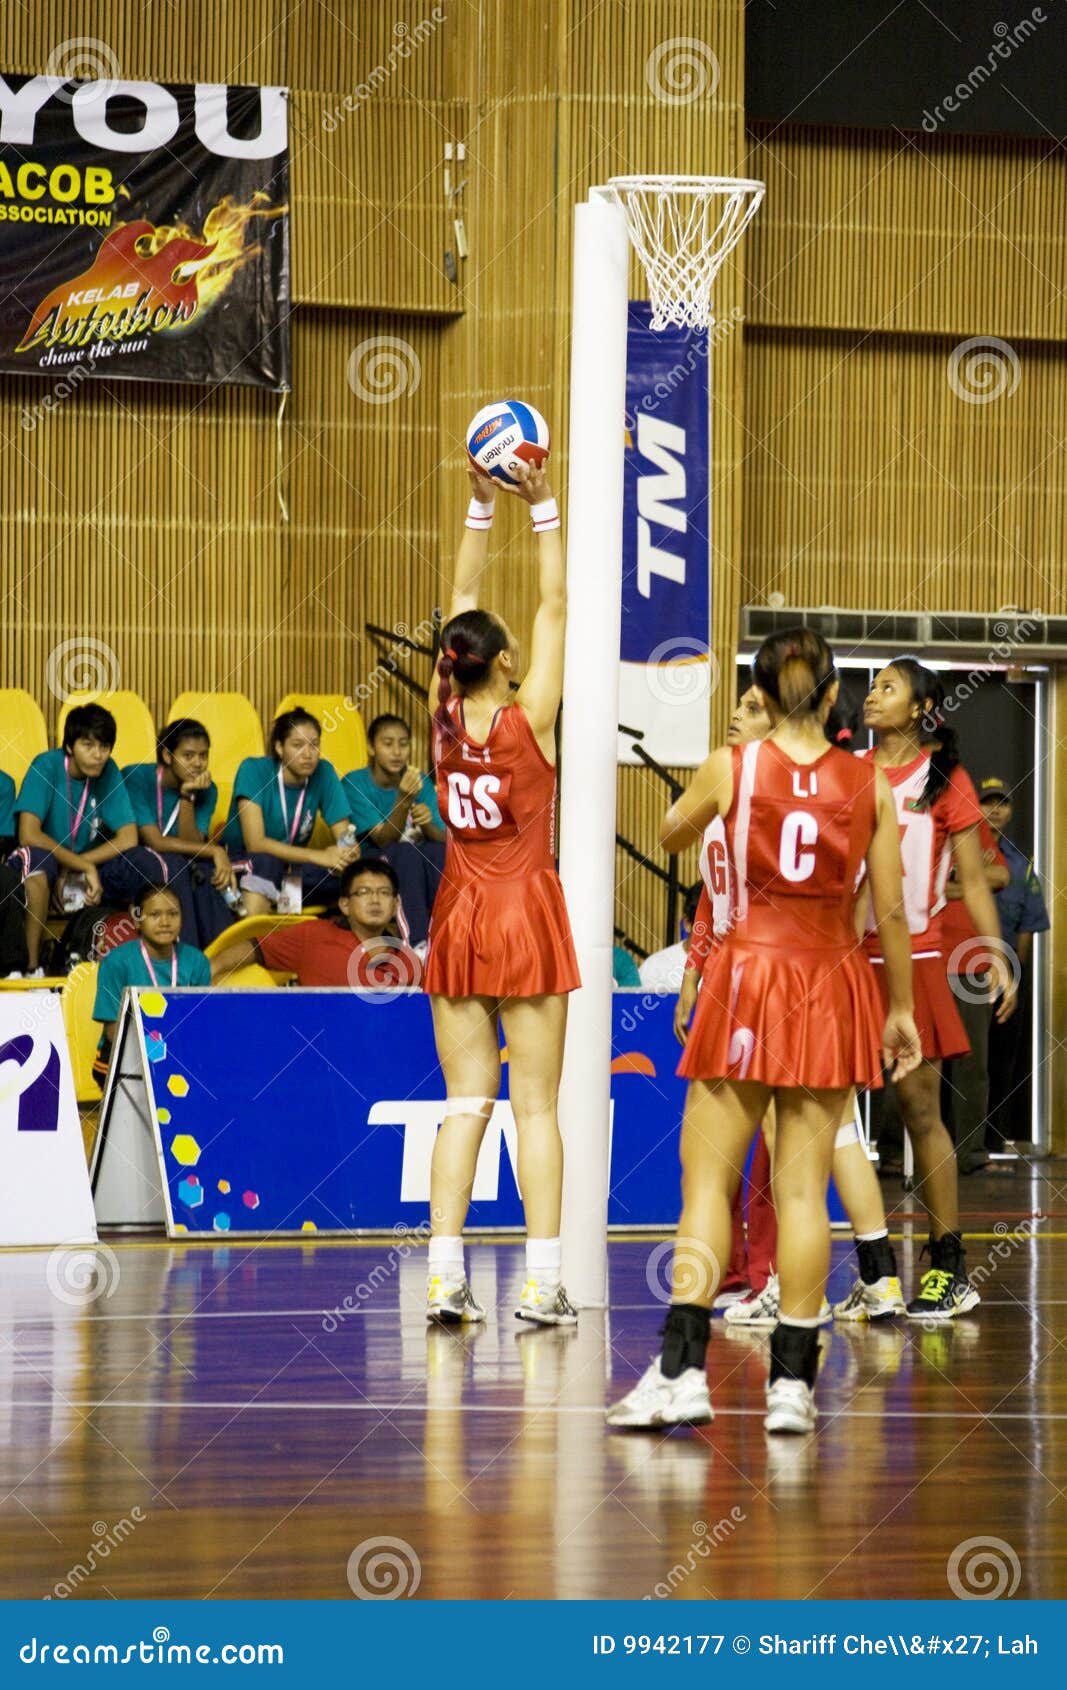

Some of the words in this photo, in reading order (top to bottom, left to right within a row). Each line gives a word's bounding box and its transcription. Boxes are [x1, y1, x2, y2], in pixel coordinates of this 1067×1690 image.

[0, 74, 289, 160] YOU
[14, 287, 198, 353] Autoshow
[66, 282, 140, 308] KELAB
[38, 347, 85, 368] chase
[482, 434, 516, 465] molten
[636, 413, 687, 599] TM
[447, 771, 503, 830] GS
[793, 771, 817, 798] LI
[779, 811, 818, 882] C
